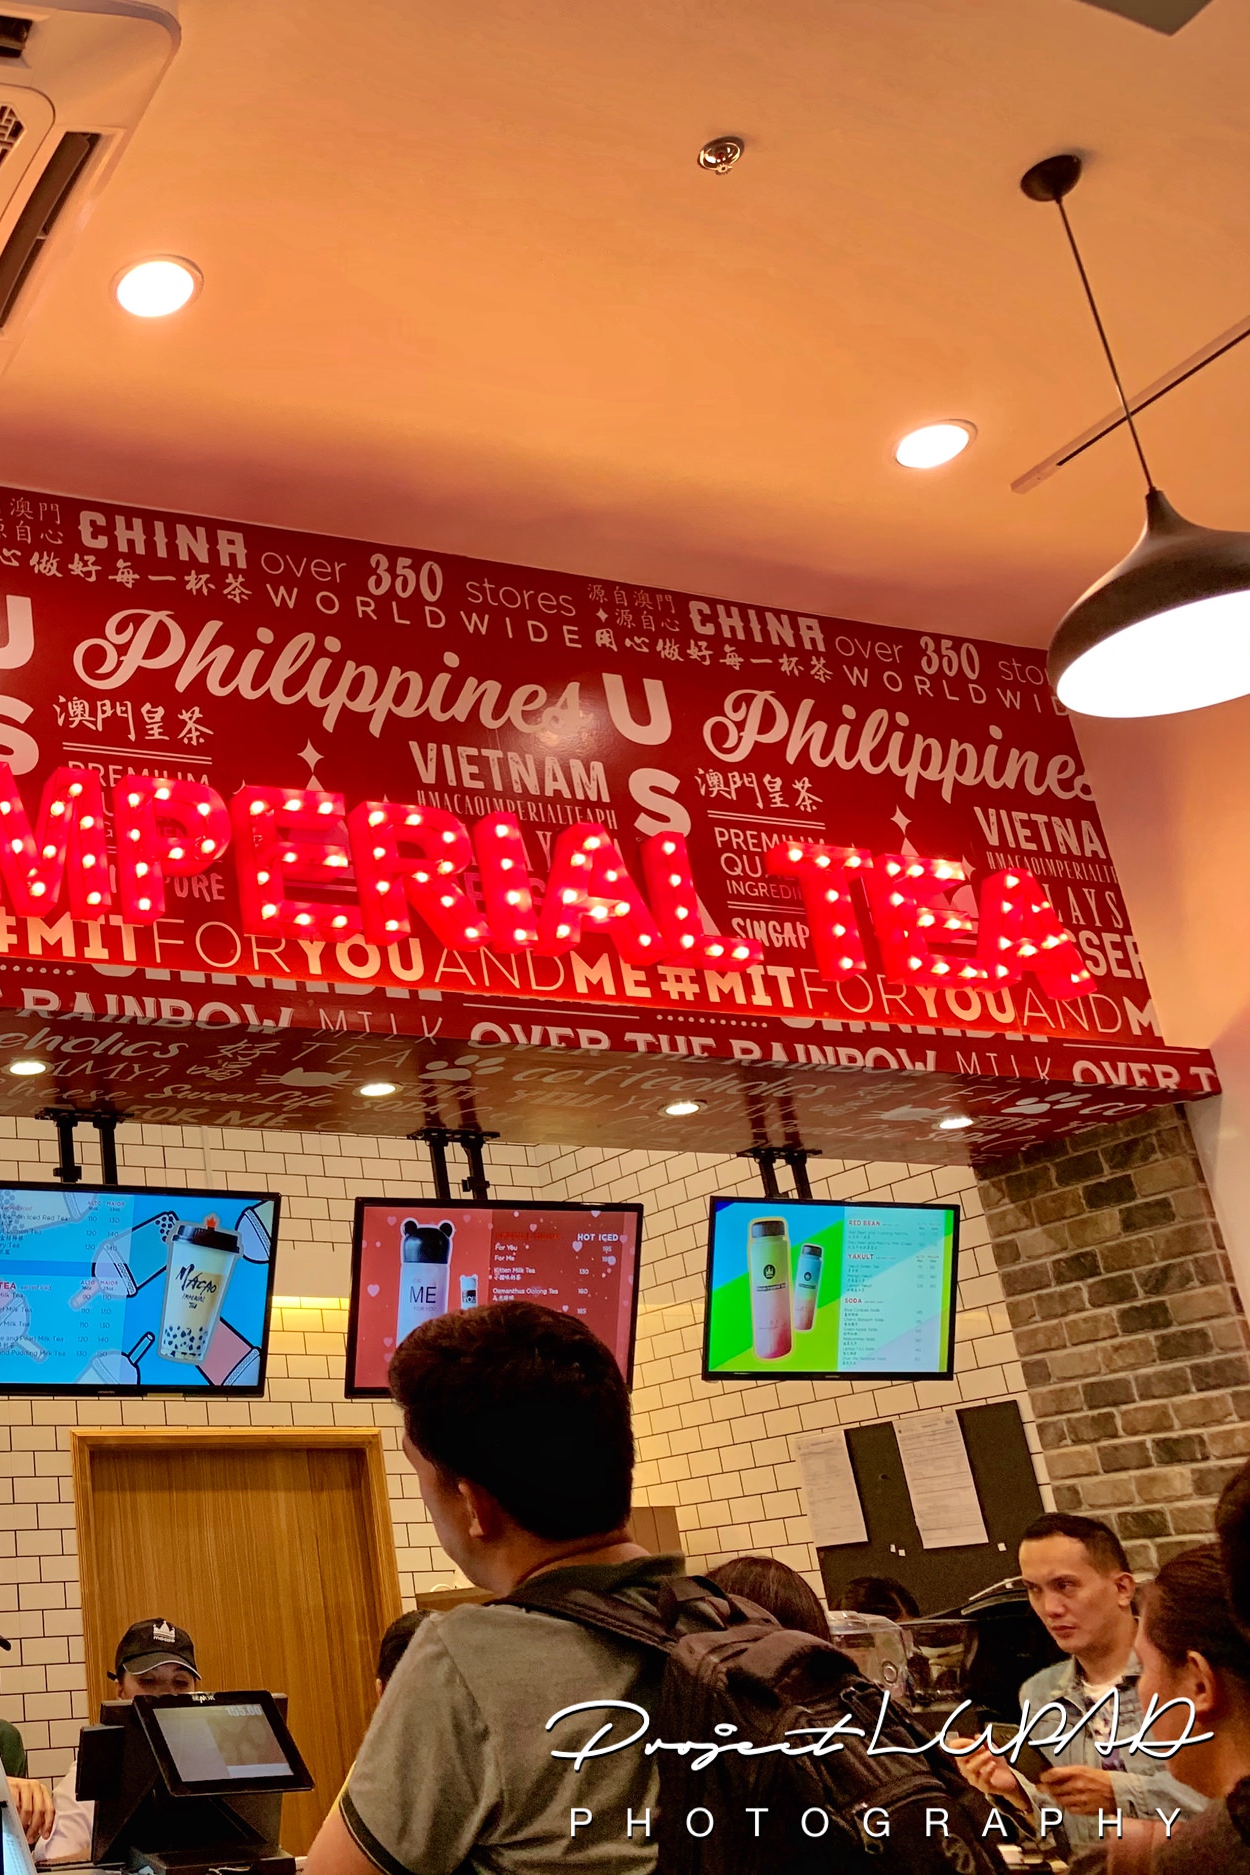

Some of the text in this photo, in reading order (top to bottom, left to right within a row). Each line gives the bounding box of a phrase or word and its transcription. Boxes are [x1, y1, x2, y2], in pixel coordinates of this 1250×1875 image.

[79, 510, 249, 569] CHINA
[260, 551, 576, 617] over 350 stores
[266, 584, 582, 649] WORLDWIDE
[688, 600, 826, 652] CHINA
[73, 608, 595, 738] Philippines
[595, 628, 833, 683] 用心做好每一杯茶
[835, 636, 980, 680] over 350
[53, 695, 214, 747] 澳門皇茶
[409, 741, 610, 803] VIETNAM
[697, 768, 823, 813] 澳門皇茶
[973, 806, 1107, 859] VIETNA
[762, 838, 1098, 1002] TEA
[15, 988, 295, 1035] RAINBOW
[313, 1008, 443, 1046] MILK
[467, 1021, 937, 1077] OVER THE RAINBOW
[577, 1233, 619, 1242] HOT ICED
[410, 1285, 437, 1304] ME
